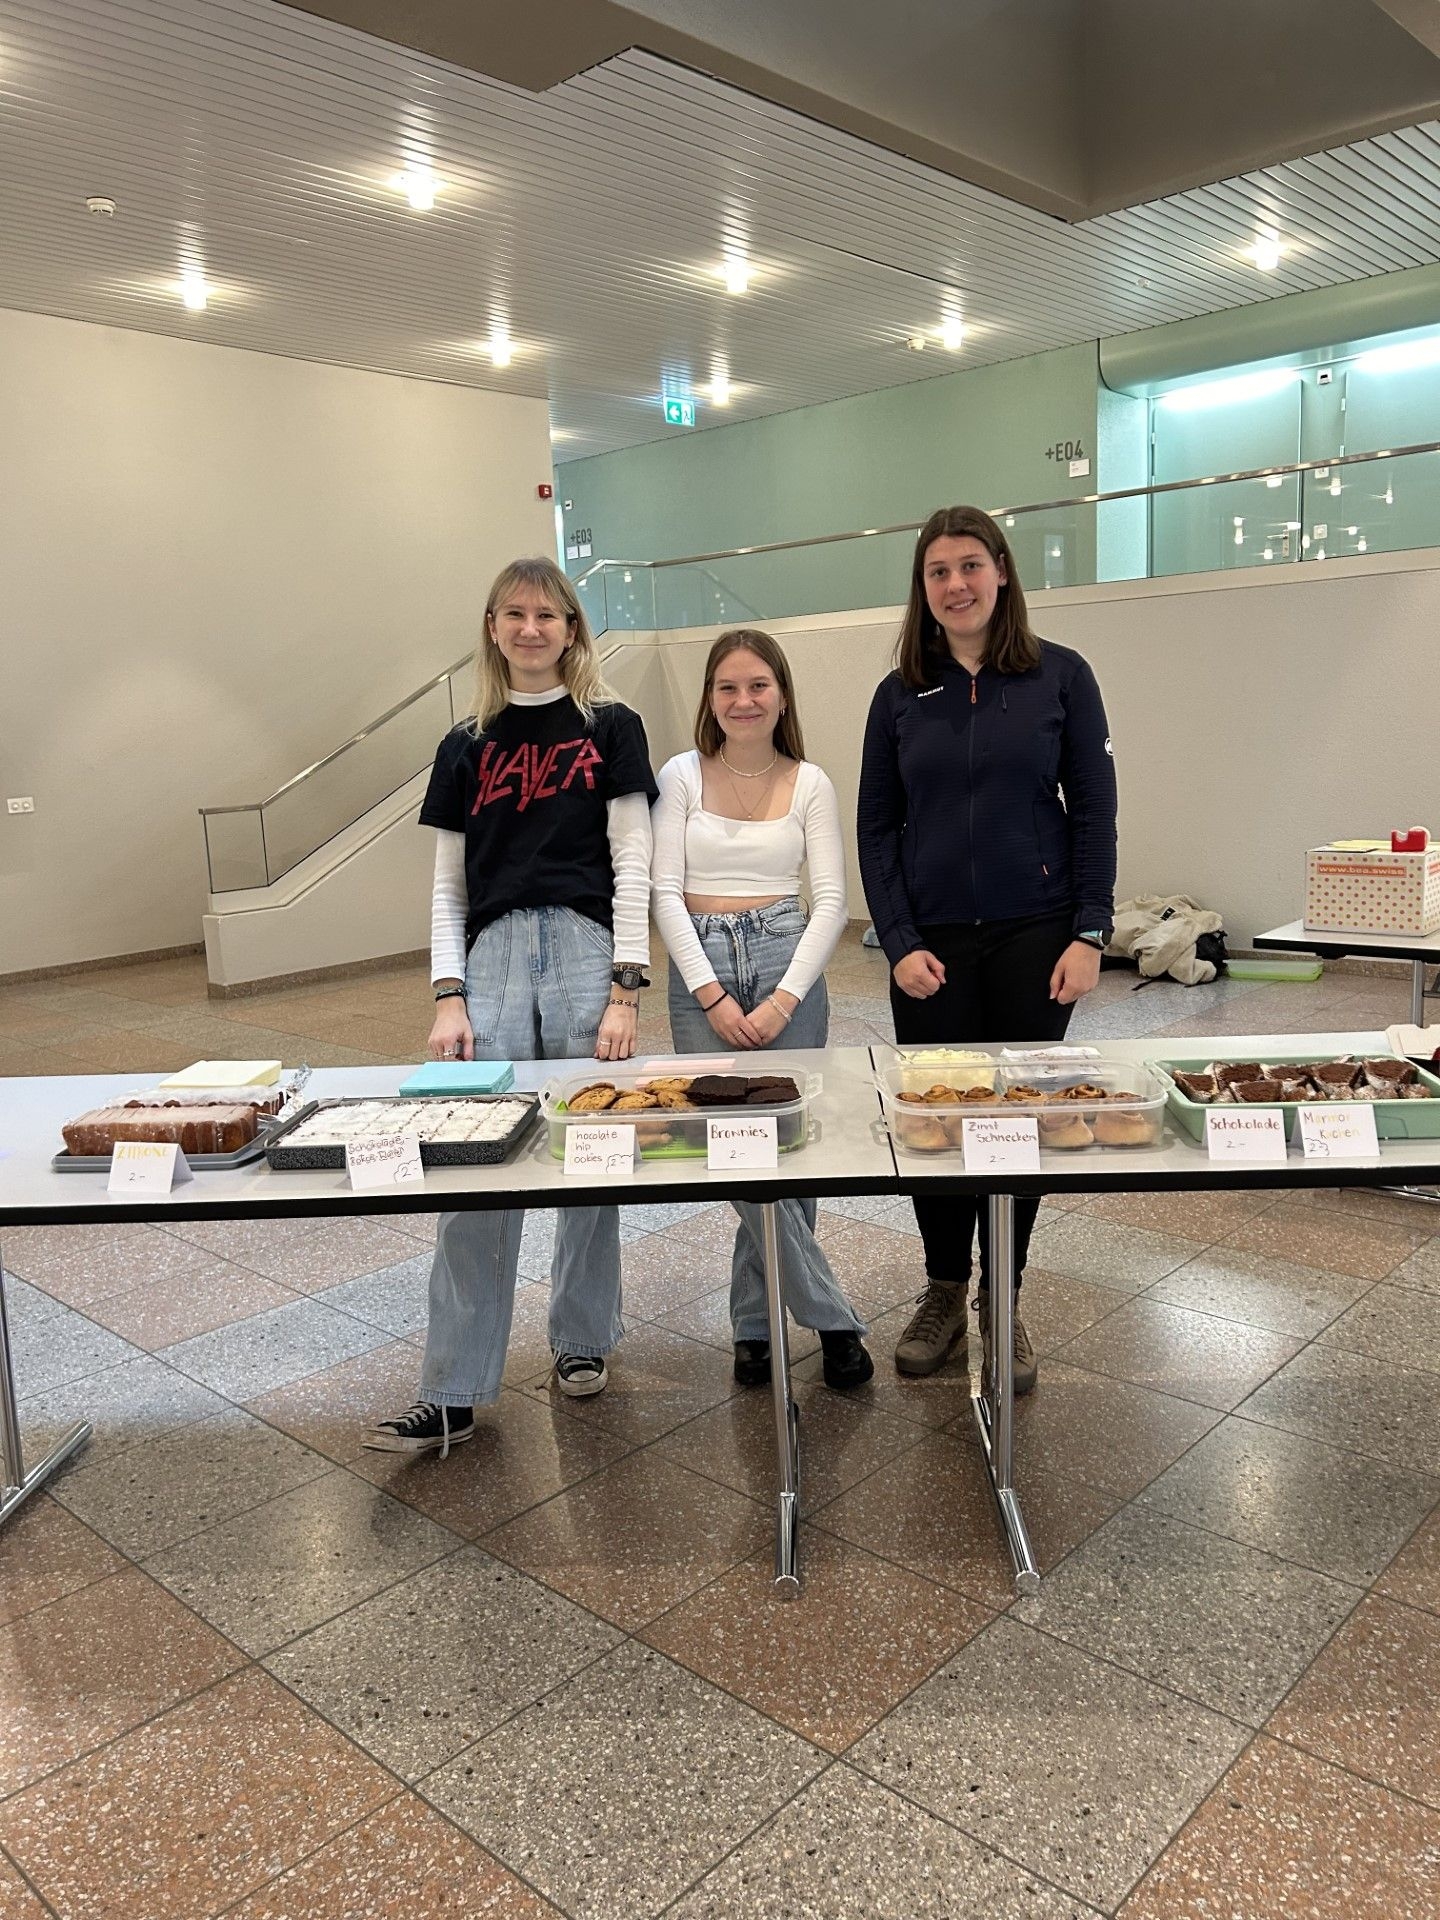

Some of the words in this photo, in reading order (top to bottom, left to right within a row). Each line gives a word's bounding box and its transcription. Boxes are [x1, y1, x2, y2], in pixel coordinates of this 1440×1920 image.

[1045, 440, 1083, 462] +E04
[570, 528, 593, 544] +E03
[470, 738, 603, 816] SLAYER
[1210, 1117, 1281, 1130] Schokolade
[569, 1129, 618, 1141] hocolate
[711, 1123, 769, 1139] Brownies
[976, 1132, 1037, 1144] Schnecken
[569, 1142, 591, 1152] hip
[568, 1152, 603, 1164] ookies
